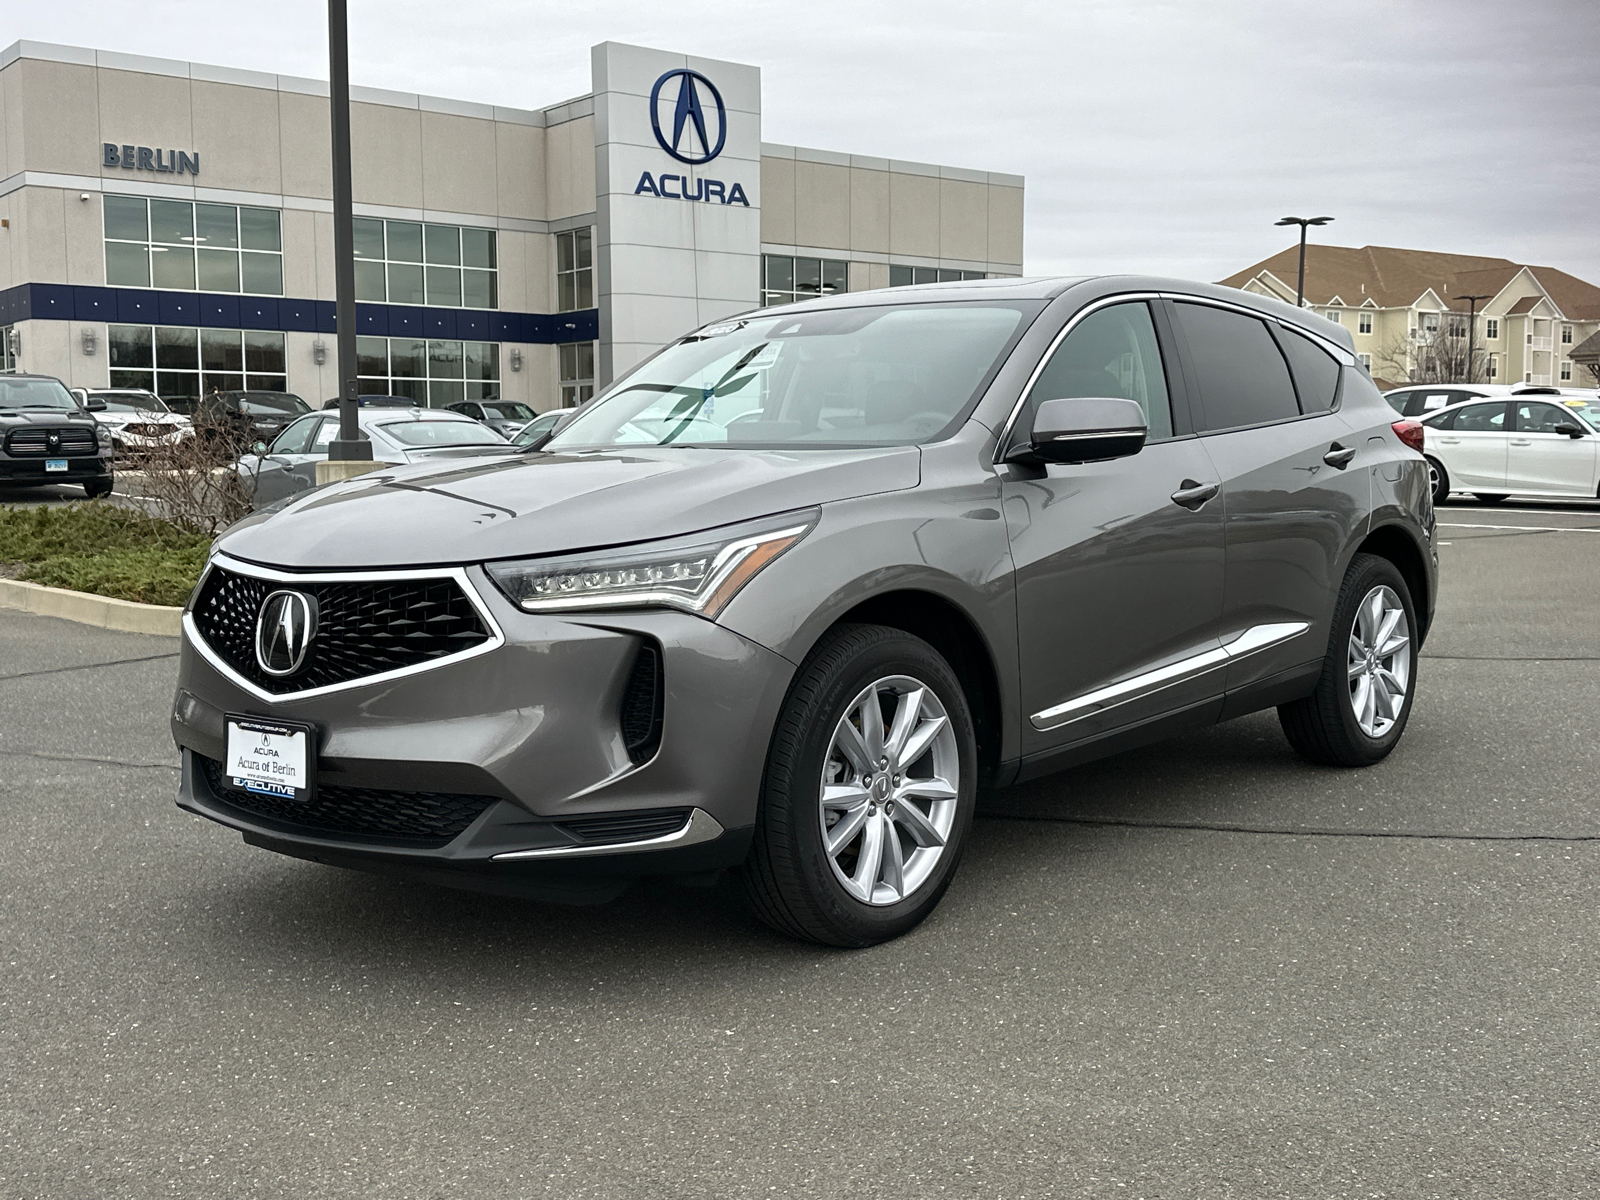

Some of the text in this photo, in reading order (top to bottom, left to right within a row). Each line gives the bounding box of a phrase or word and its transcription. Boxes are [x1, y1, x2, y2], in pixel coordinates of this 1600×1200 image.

[103, 142, 199, 175] BERLIN
[634, 171, 750, 207] ACURA
[253, 747, 280, 758] ACURA
[237, 756, 296, 777] Acura of Berlin
[233, 777, 295, 797] EXECUTIVE
